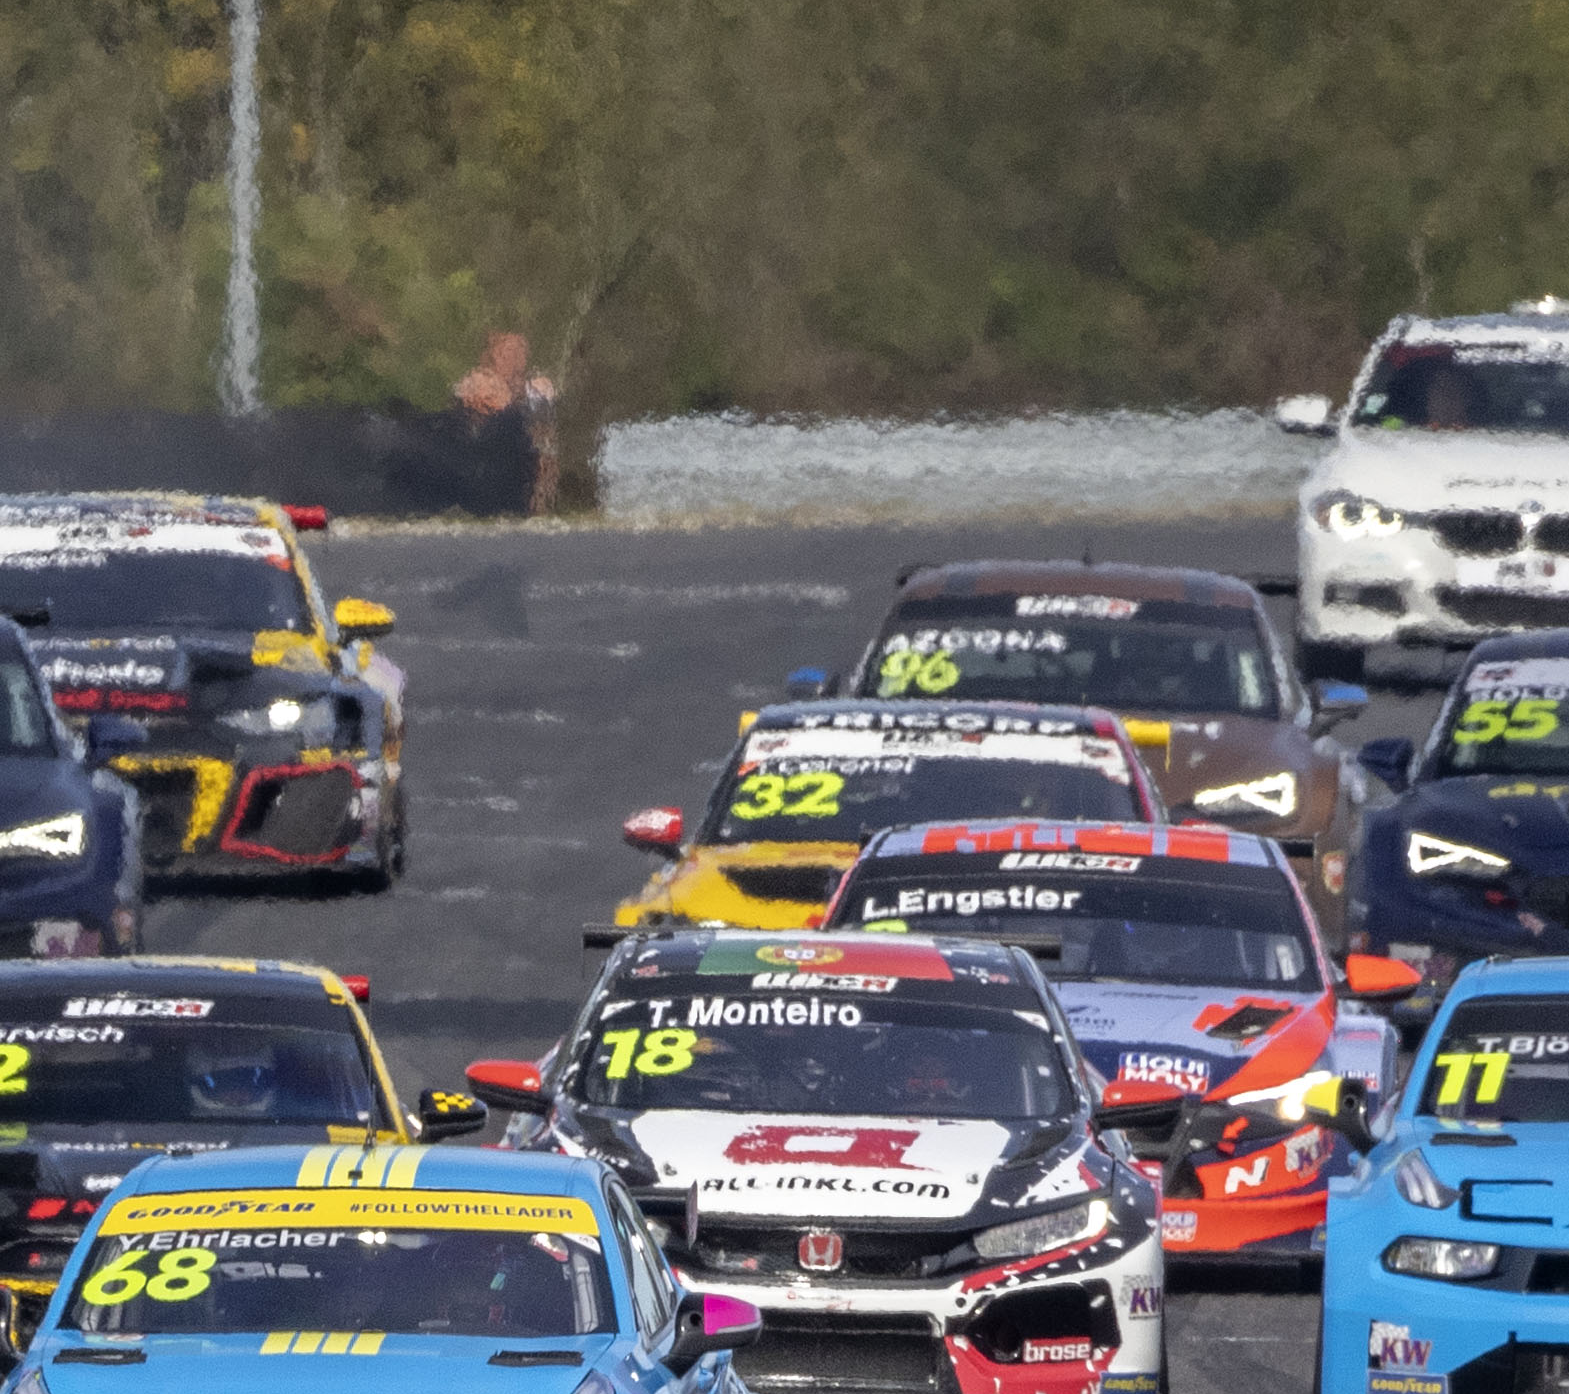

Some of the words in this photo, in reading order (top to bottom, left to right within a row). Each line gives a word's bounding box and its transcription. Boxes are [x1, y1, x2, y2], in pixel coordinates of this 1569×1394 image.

[876, 650, 962, 698] 96
[1452, 699, 1561, 745] 55
[731, 772, 846, 821] 32
[648, 999, 677, 1028] T.
[687, 997, 863, 1028] Monteiro
[602, 1027, 698, 1081] 18
[1123, 1053, 1207, 1076] LIQUI
[1435, 1052, 1512, 1105] 11
[125, 1200, 317, 1222] GOODYEAR
[348, 1202, 575, 1221] #FOLLOWTHELEADER
[81, 1247, 219, 1307] 68
[1023, 1339, 1092, 1362] brose
[1379, 1337, 1433, 1369] KW
